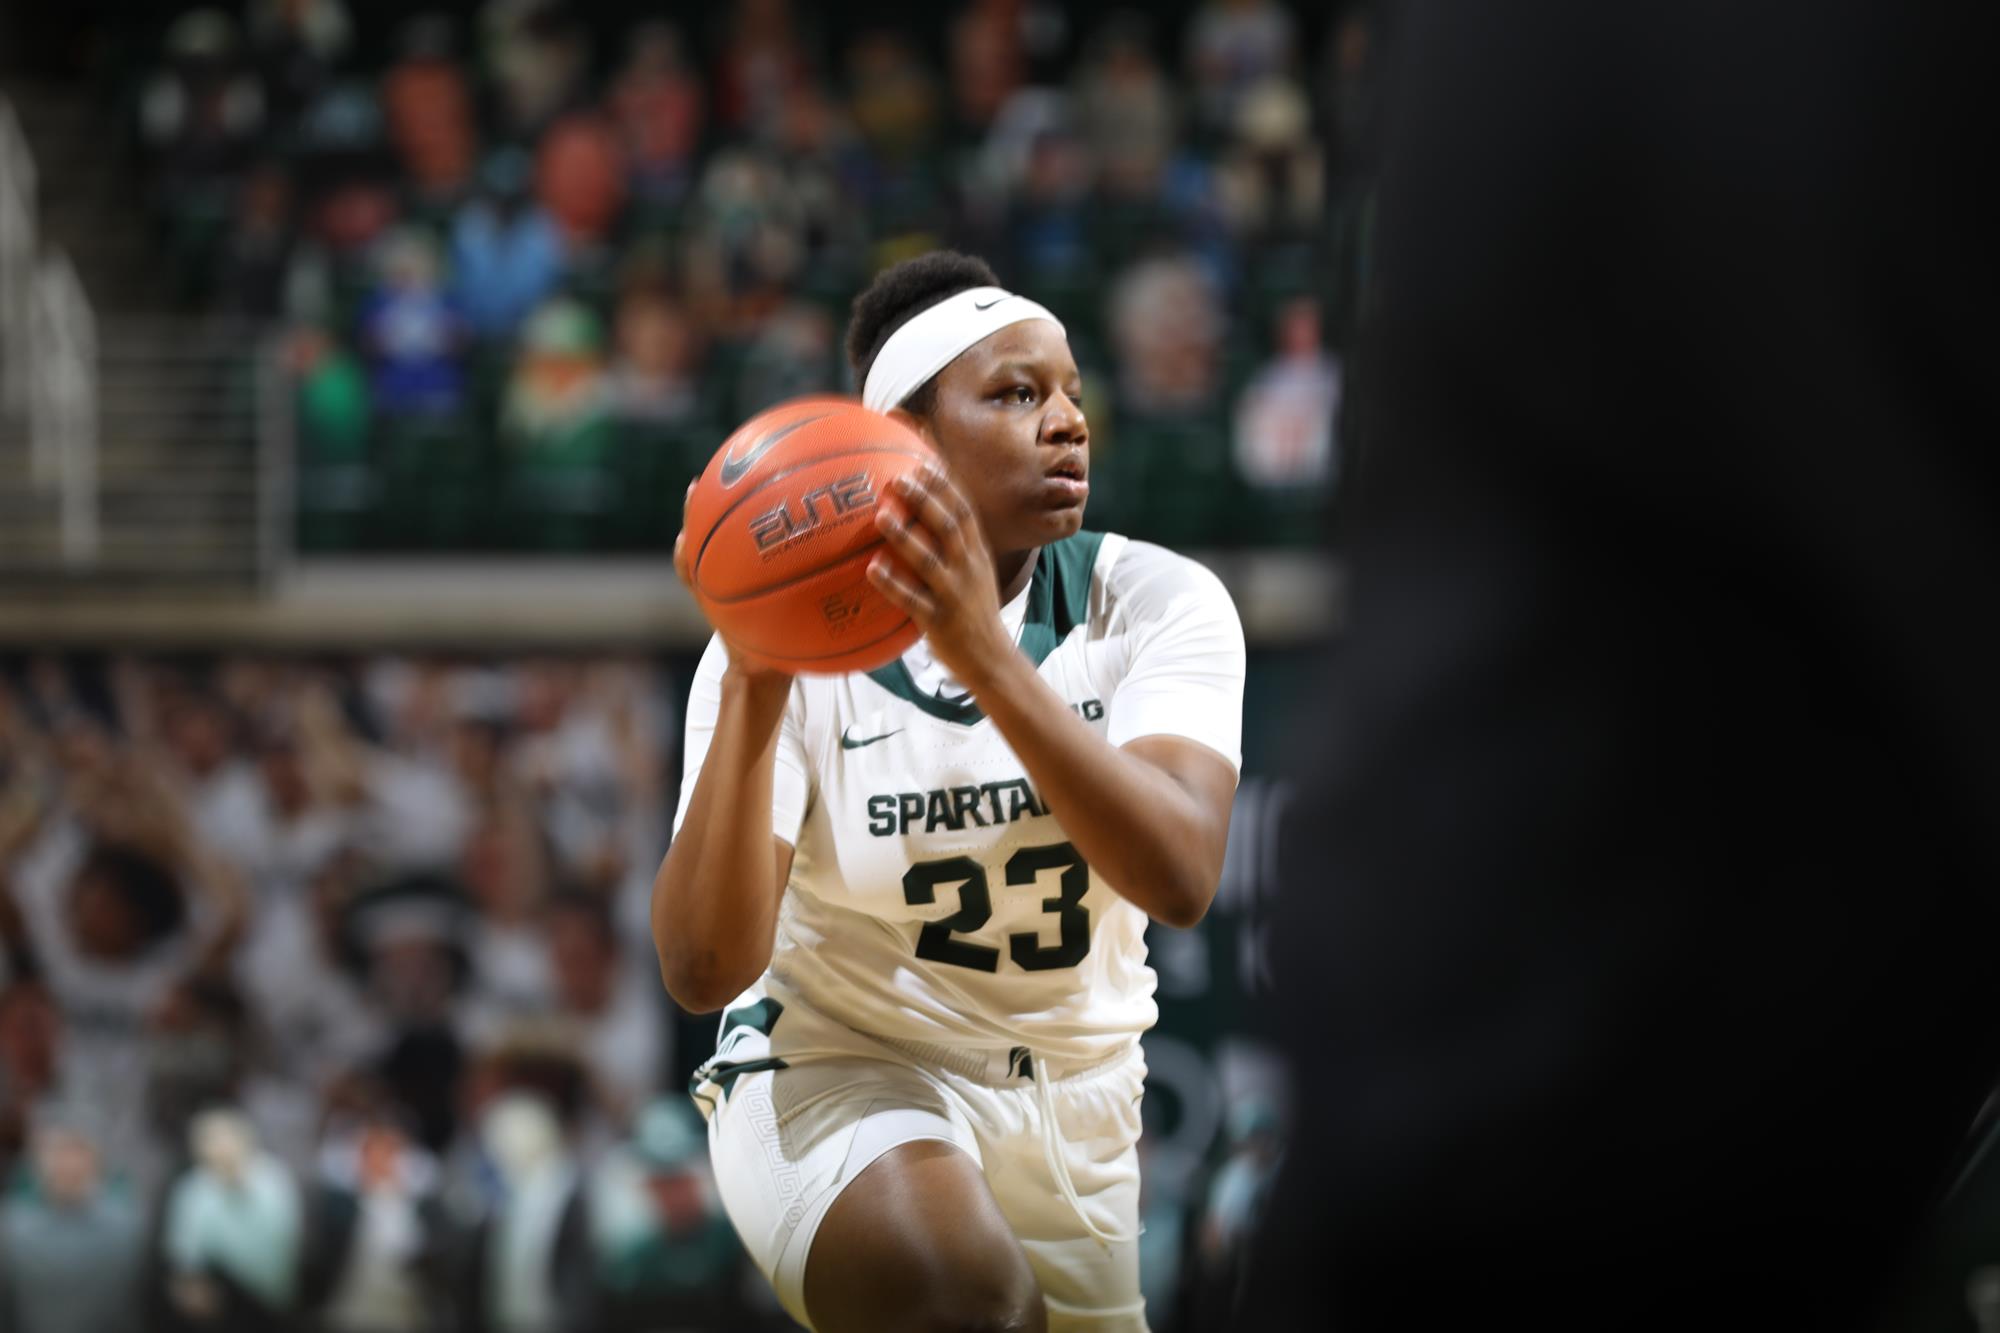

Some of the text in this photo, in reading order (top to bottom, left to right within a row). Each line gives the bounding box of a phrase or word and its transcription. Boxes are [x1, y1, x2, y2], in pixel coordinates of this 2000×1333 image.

[749, 471, 877, 555] ELITE
[868, 777, 1051, 837] SPARTA
[902, 841, 1090, 973] 23
